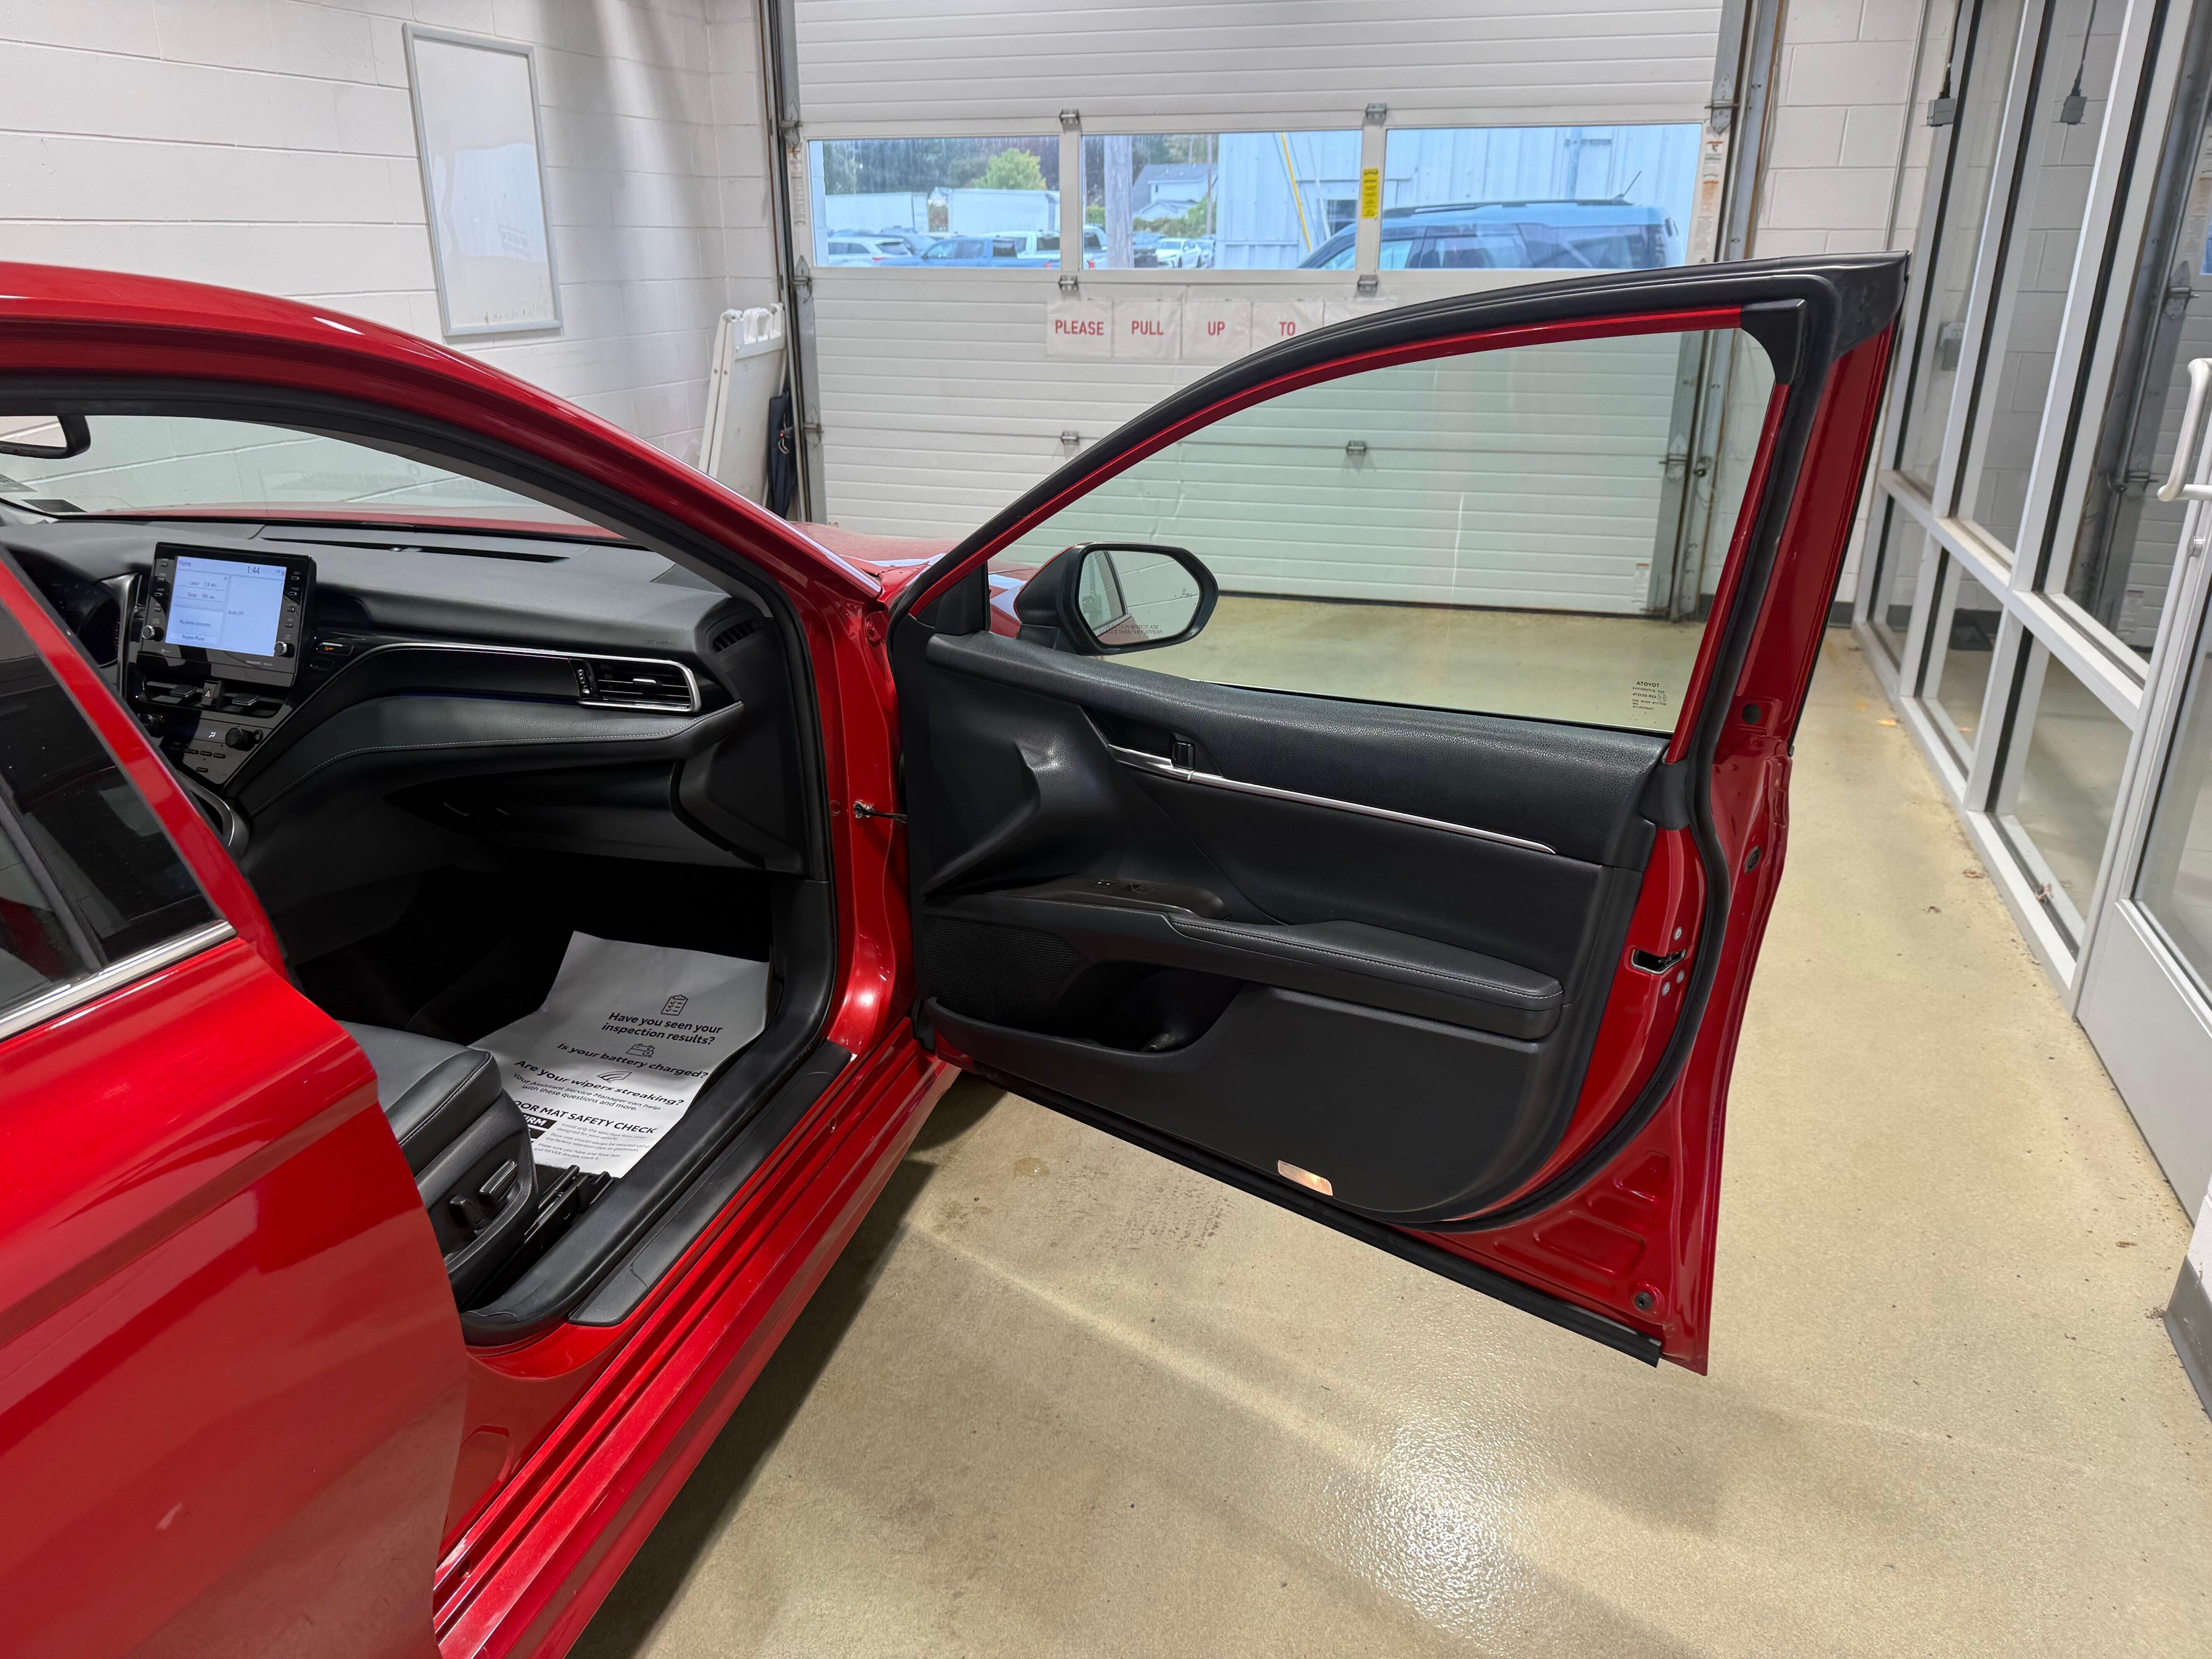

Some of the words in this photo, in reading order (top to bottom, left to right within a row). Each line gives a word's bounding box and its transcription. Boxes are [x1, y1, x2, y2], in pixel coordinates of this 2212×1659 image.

[1055, 320, 1104, 335] PLEASE
[1131, 320, 1163, 335] PULL
[1207, 321, 1225, 336] UP
[1279, 321, 1296, 336] TO
[247, 566, 259, 574] 1:44
[602, 1022, 665, 1038] inspection
[666, 1032, 715, 1045] results?
[608, 1012, 638, 1023] Have
[638, 1018, 663, 1026] you
[664, 1021, 692, 1030] seen
[693, 1025, 723, 1033] your
[567, 1048, 600, 1057] your
[600, 1053, 648, 1068] battery
[649, 1064, 708, 1078] charged?
[514, 1061, 539, 1071] Are
[537, 1069, 570, 1082] your
[571, 1080, 613, 1091] wipers
[615, 1088, 684, 1105] streaking?
[514, 1073, 531, 1084] Your
[529, 1082, 565, 1091] Assistant
[565, 1087, 592, 1096] Service
[593, 1093, 627, 1103] Manager
[562, 1093, 598, 1103] questions
[540, 1108, 568, 1117] MAT
[567, 1114, 614, 1127] SAFETY
[614, 1123, 658, 1133] CHECK
